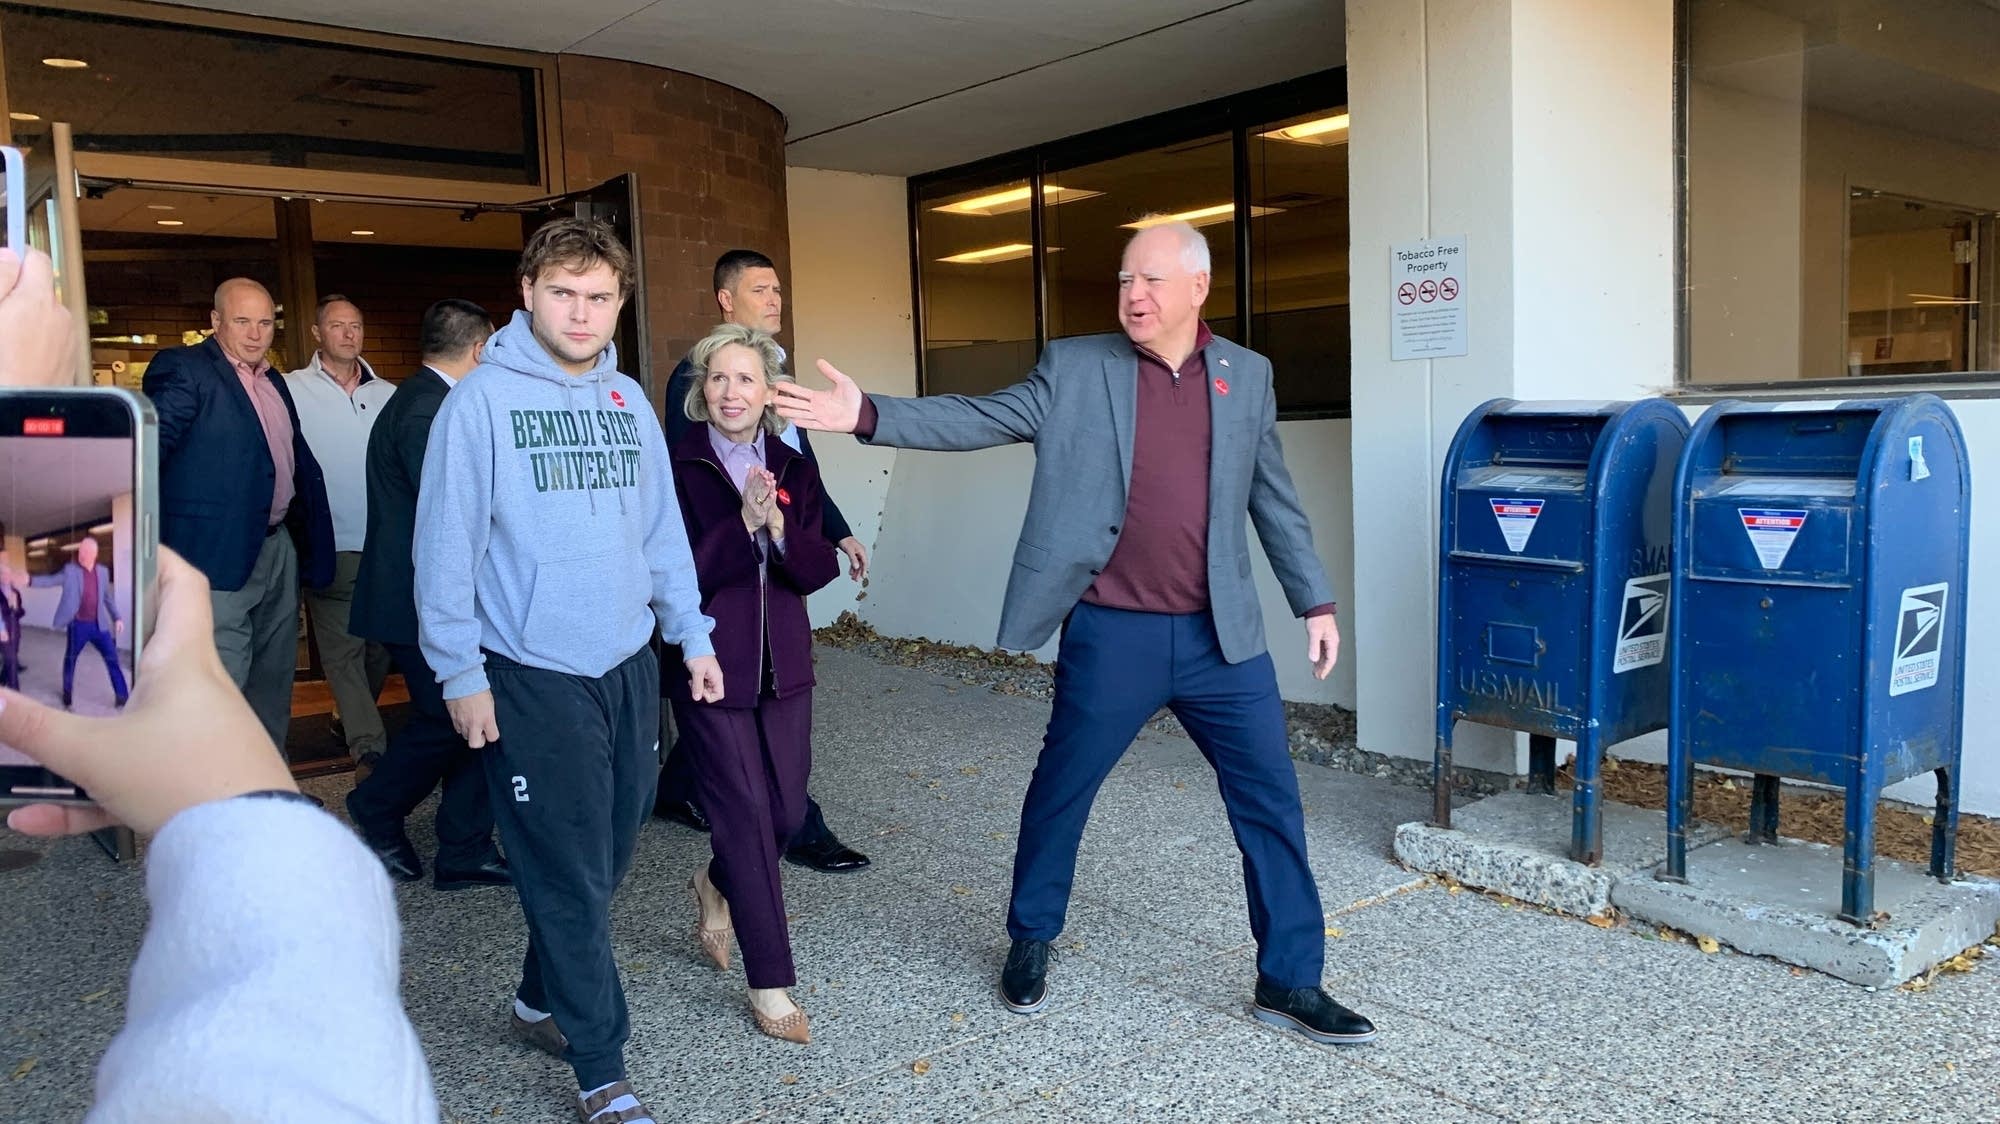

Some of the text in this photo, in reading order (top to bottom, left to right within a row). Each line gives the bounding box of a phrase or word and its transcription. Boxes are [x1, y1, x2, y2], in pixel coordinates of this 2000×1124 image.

[1397, 246, 1459, 261] Tobacco Free
[1407, 261, 1448, 274] Property
[510, 410, 642, 449] BEMIDJI STATE
[511, 775, 530, 802] 2
